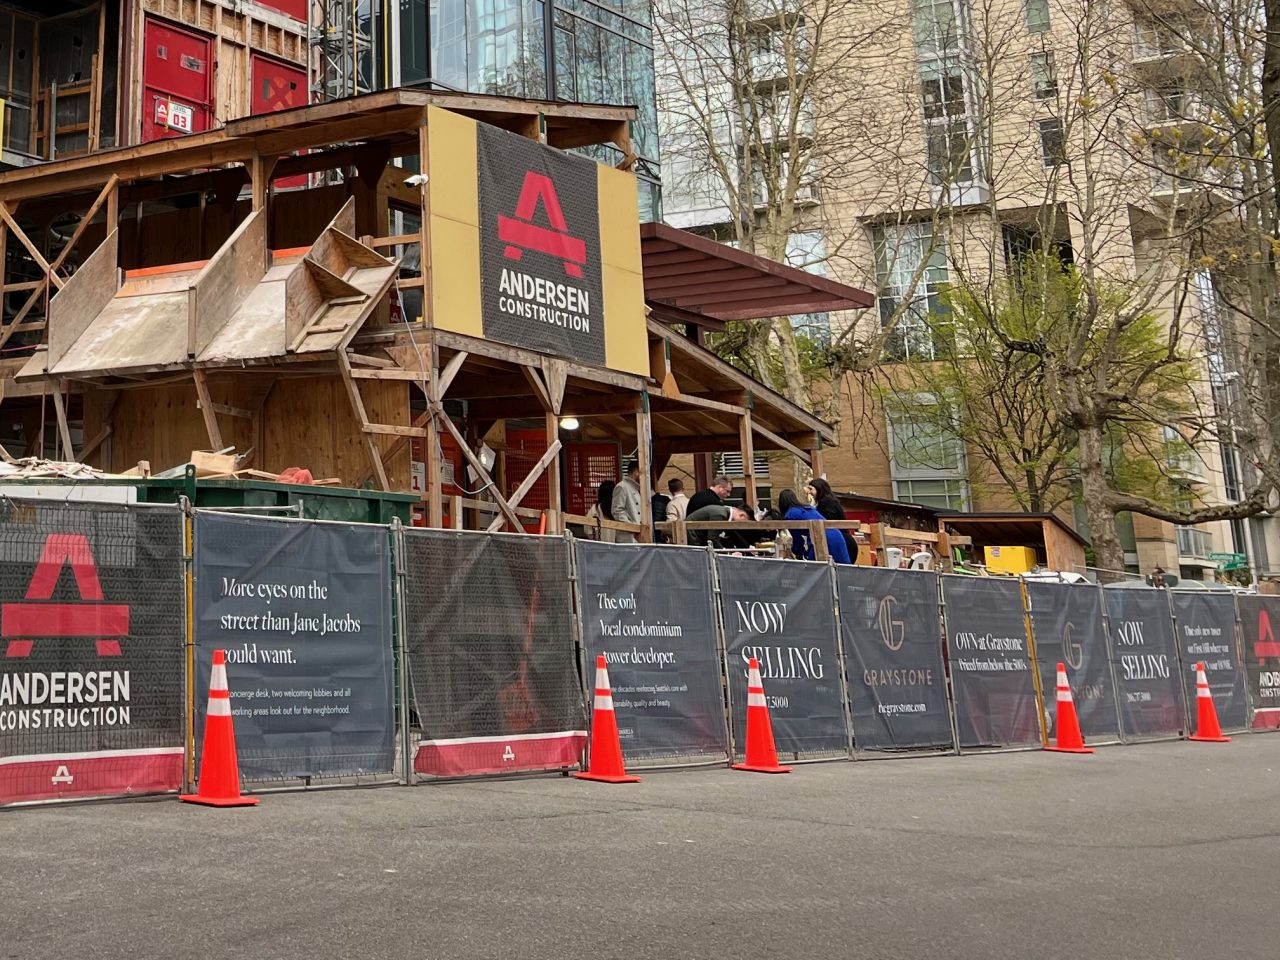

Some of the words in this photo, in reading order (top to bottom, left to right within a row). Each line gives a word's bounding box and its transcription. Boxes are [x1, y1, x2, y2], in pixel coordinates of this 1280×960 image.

[173, 114, 187, 128] 03
[498, 268, 590, 316] ANDERSEN
[499, 296, 590, 334] CONSTRUCTION
[221, 577, 256, 598] More
[257, 584, 288, 604] eyes
[289, 586, 306, 599] on
[308, 580, 328, 600] the
[597, 592, 618, 610] The
[618, 592, 638, 615] only
[220, 614, 259, 631] street
[261, 611, 290, 631] than
[291, 612, 320, 636] Jane
[320, 613, 361, 636] Jacobs
[599, 619, 622, 637] local
[622, 619, 683, 637] condominium
[734, 600, 788, 634] NOW
[955, 632, 978, 651] OWN
[978, 636, 987, 651] at
[986, 632, 1023, 657] Graystone
[1117, 620, 1144, 646] NOW
[223, 643, 257, 664] could
[260, 648, 297, 664] want.
[603, 649, 630, 664] tower
[631, 646, 676, 669] developer.
[741, 645, 825, 680] SELLING
[863, 669, 933, 686] GRAYSTONE
[1121, 654, 1170, 681] SELLING
[0, 670, 131, 707] ANDERSEN
[255, 688, 271, 699] desk,
[272, 689, 283, 698] two
[284, 688, 313, 700] welcoming
[313, 687, 333, 698] lobbies
[333, 687, 344, 697] and
[344, 688, 352, 697] all
[253, 708, 269, 716] areas
[269, 706, 282, 716] look
[283, 707, 293, 716] out
[293, 705, 302, 715] for
[302, 705, 313, 715] the
[312, 704, 351, 717] neighborhood.
[648, 699, 657, 707] and
[0, 705, 131, 731] CONSTRUCTION
